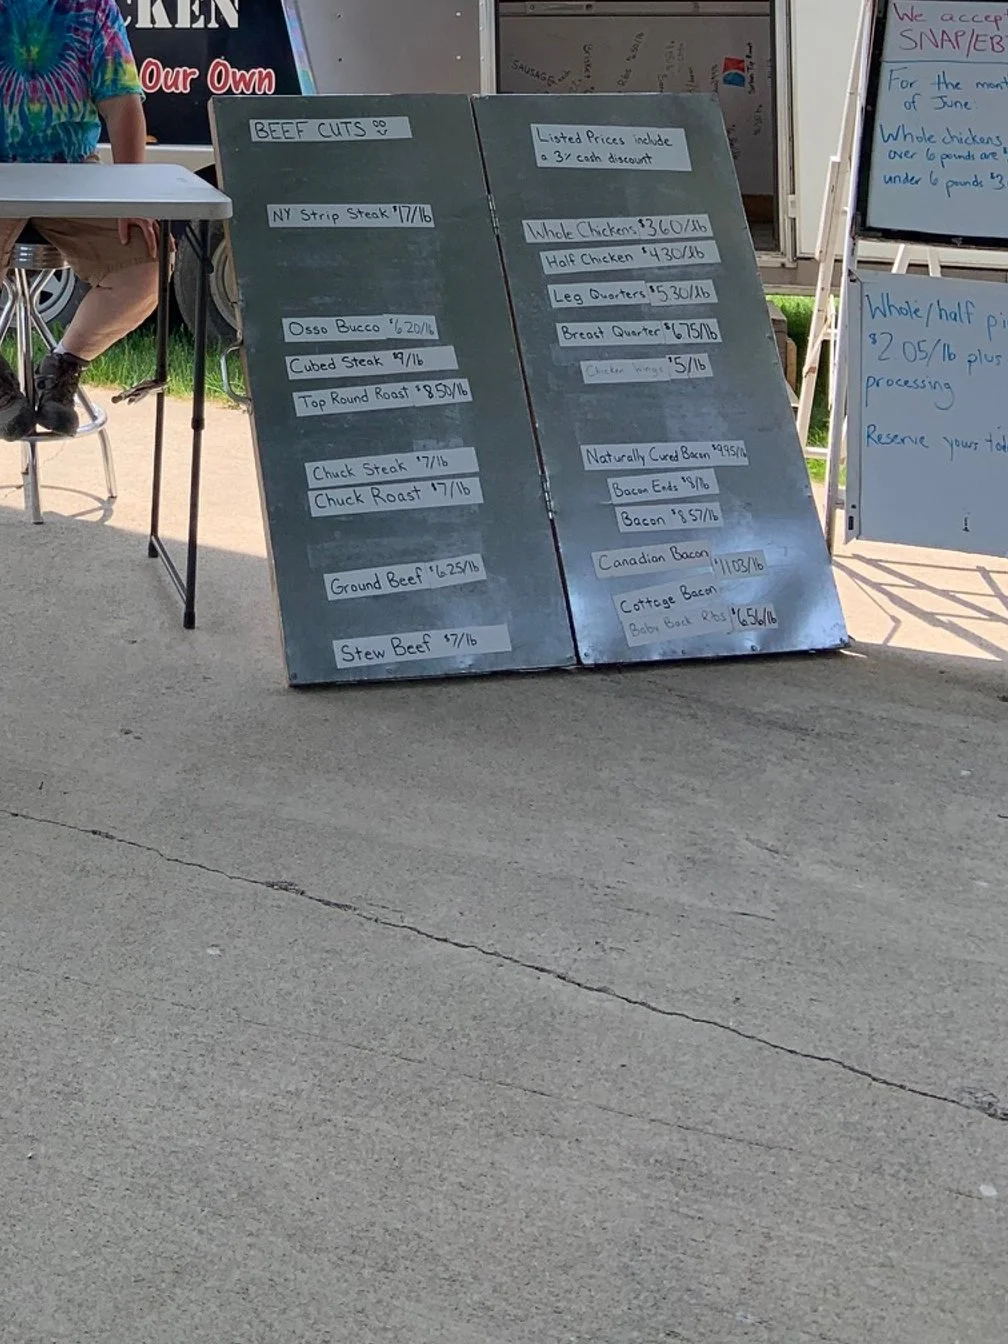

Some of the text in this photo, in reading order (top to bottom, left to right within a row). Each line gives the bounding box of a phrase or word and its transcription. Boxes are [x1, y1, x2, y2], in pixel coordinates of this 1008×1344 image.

[894, 3, 926, 22] We
[140, 58, 275, 94] Our Own
[888, 67, 962, 91] For the
[904, 94, 921, 111] of
[254, 121, 366, 140] BEEF CUTS
[536, 129, 673, 147] Listed Prices include
[880, 124, 1002, 146] Whole chickens
[577, 150, 652, 165] cash discount
[888, 148, 975, 168] over 6 pounds
[883, 172, 983, 198] under pounds
[273, 209, 291, 222] NY
[301, 209, 341, 225] Strip
[347, 208, 390, 221] Steak
[527, 220, 636, 240] Whole Chickens
[546, 251, 634, 268] Half Chicken
[553, 288, 646, 304] Leg Quarters
[865, 292, 975, 327] Whole/half
[289, 318, 380, 336] Osso Bucco
[562, 324, 661, 340] Breast Quarter
[289, 353, 385, 374] Cubed Steak
[967, 349, 1002, 376] plus
[298, 385, 410, 416] Top Round Roast
[865, 376, 955, 410] processing
[866, 424, 979, 461] Reserve yours
[586, 447, 646, 466] Naturally
[313, 459, 408, 481] Chuck Steak
[314, 486, 422, 510] Chuck Roast
[612, 480, 650, 498] Bacon
[620, 513, 665, 528] Bacon
[598, 545, 710, 572] Canadian Bacon
[330, 565, 423, 595] Ground Beef
[620, 596, 676, 614] Cottage
[340, 633, 433, 663] Stew Beef
